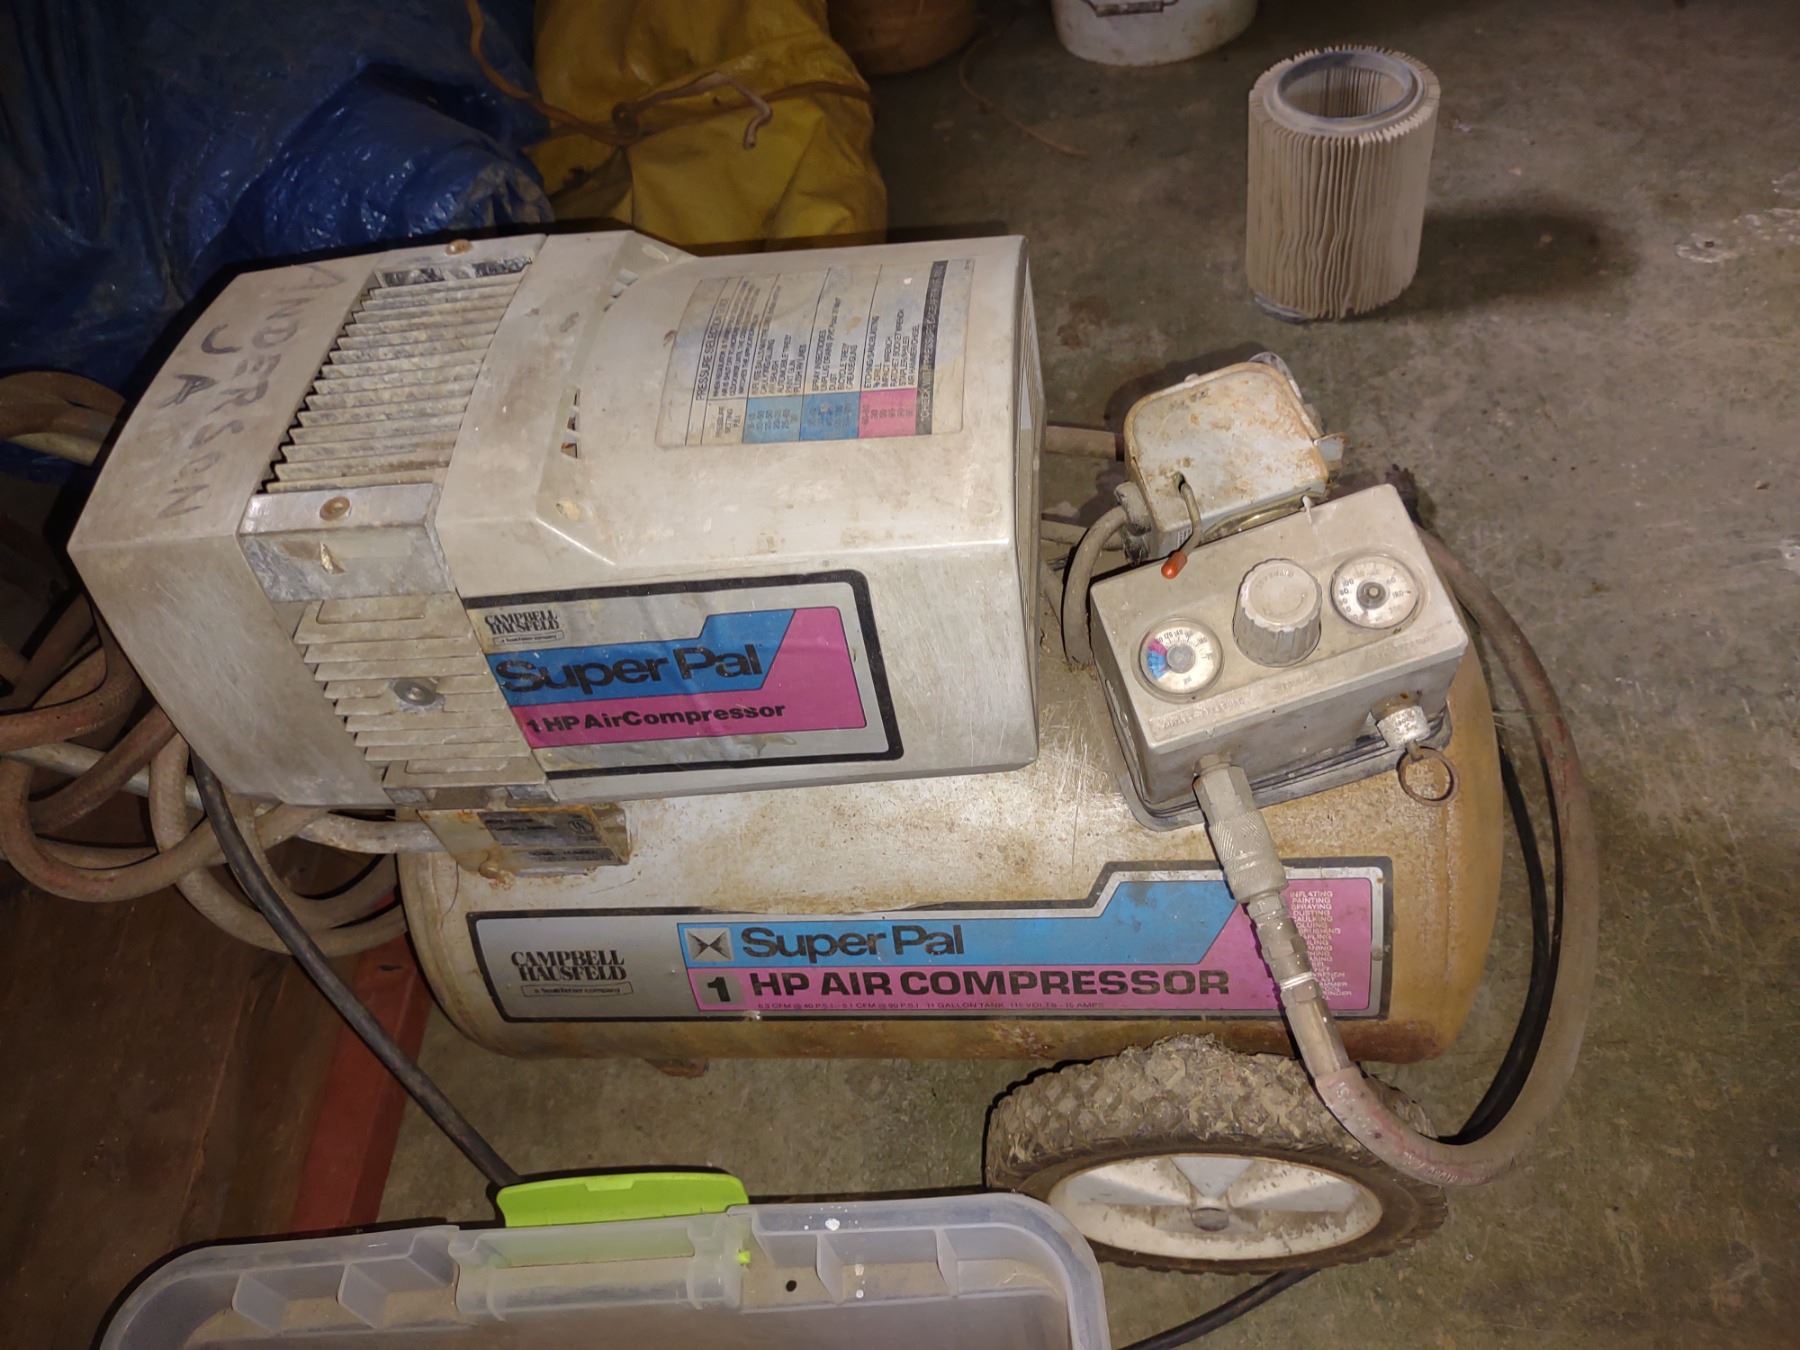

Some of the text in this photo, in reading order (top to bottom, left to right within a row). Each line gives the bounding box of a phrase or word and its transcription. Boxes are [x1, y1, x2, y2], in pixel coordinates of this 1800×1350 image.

[495, 643, 763, 696] Super Pal
[545, 715, 581, 733] HP
[741, 923, 965, 963] Super Pal
[511, 949, 625, 967] CAMPBELL
[518, 964, 628, 982] HAUSFELD
[706, 968, 1230, 1003] 1 HP AIR COMPRESSOR
